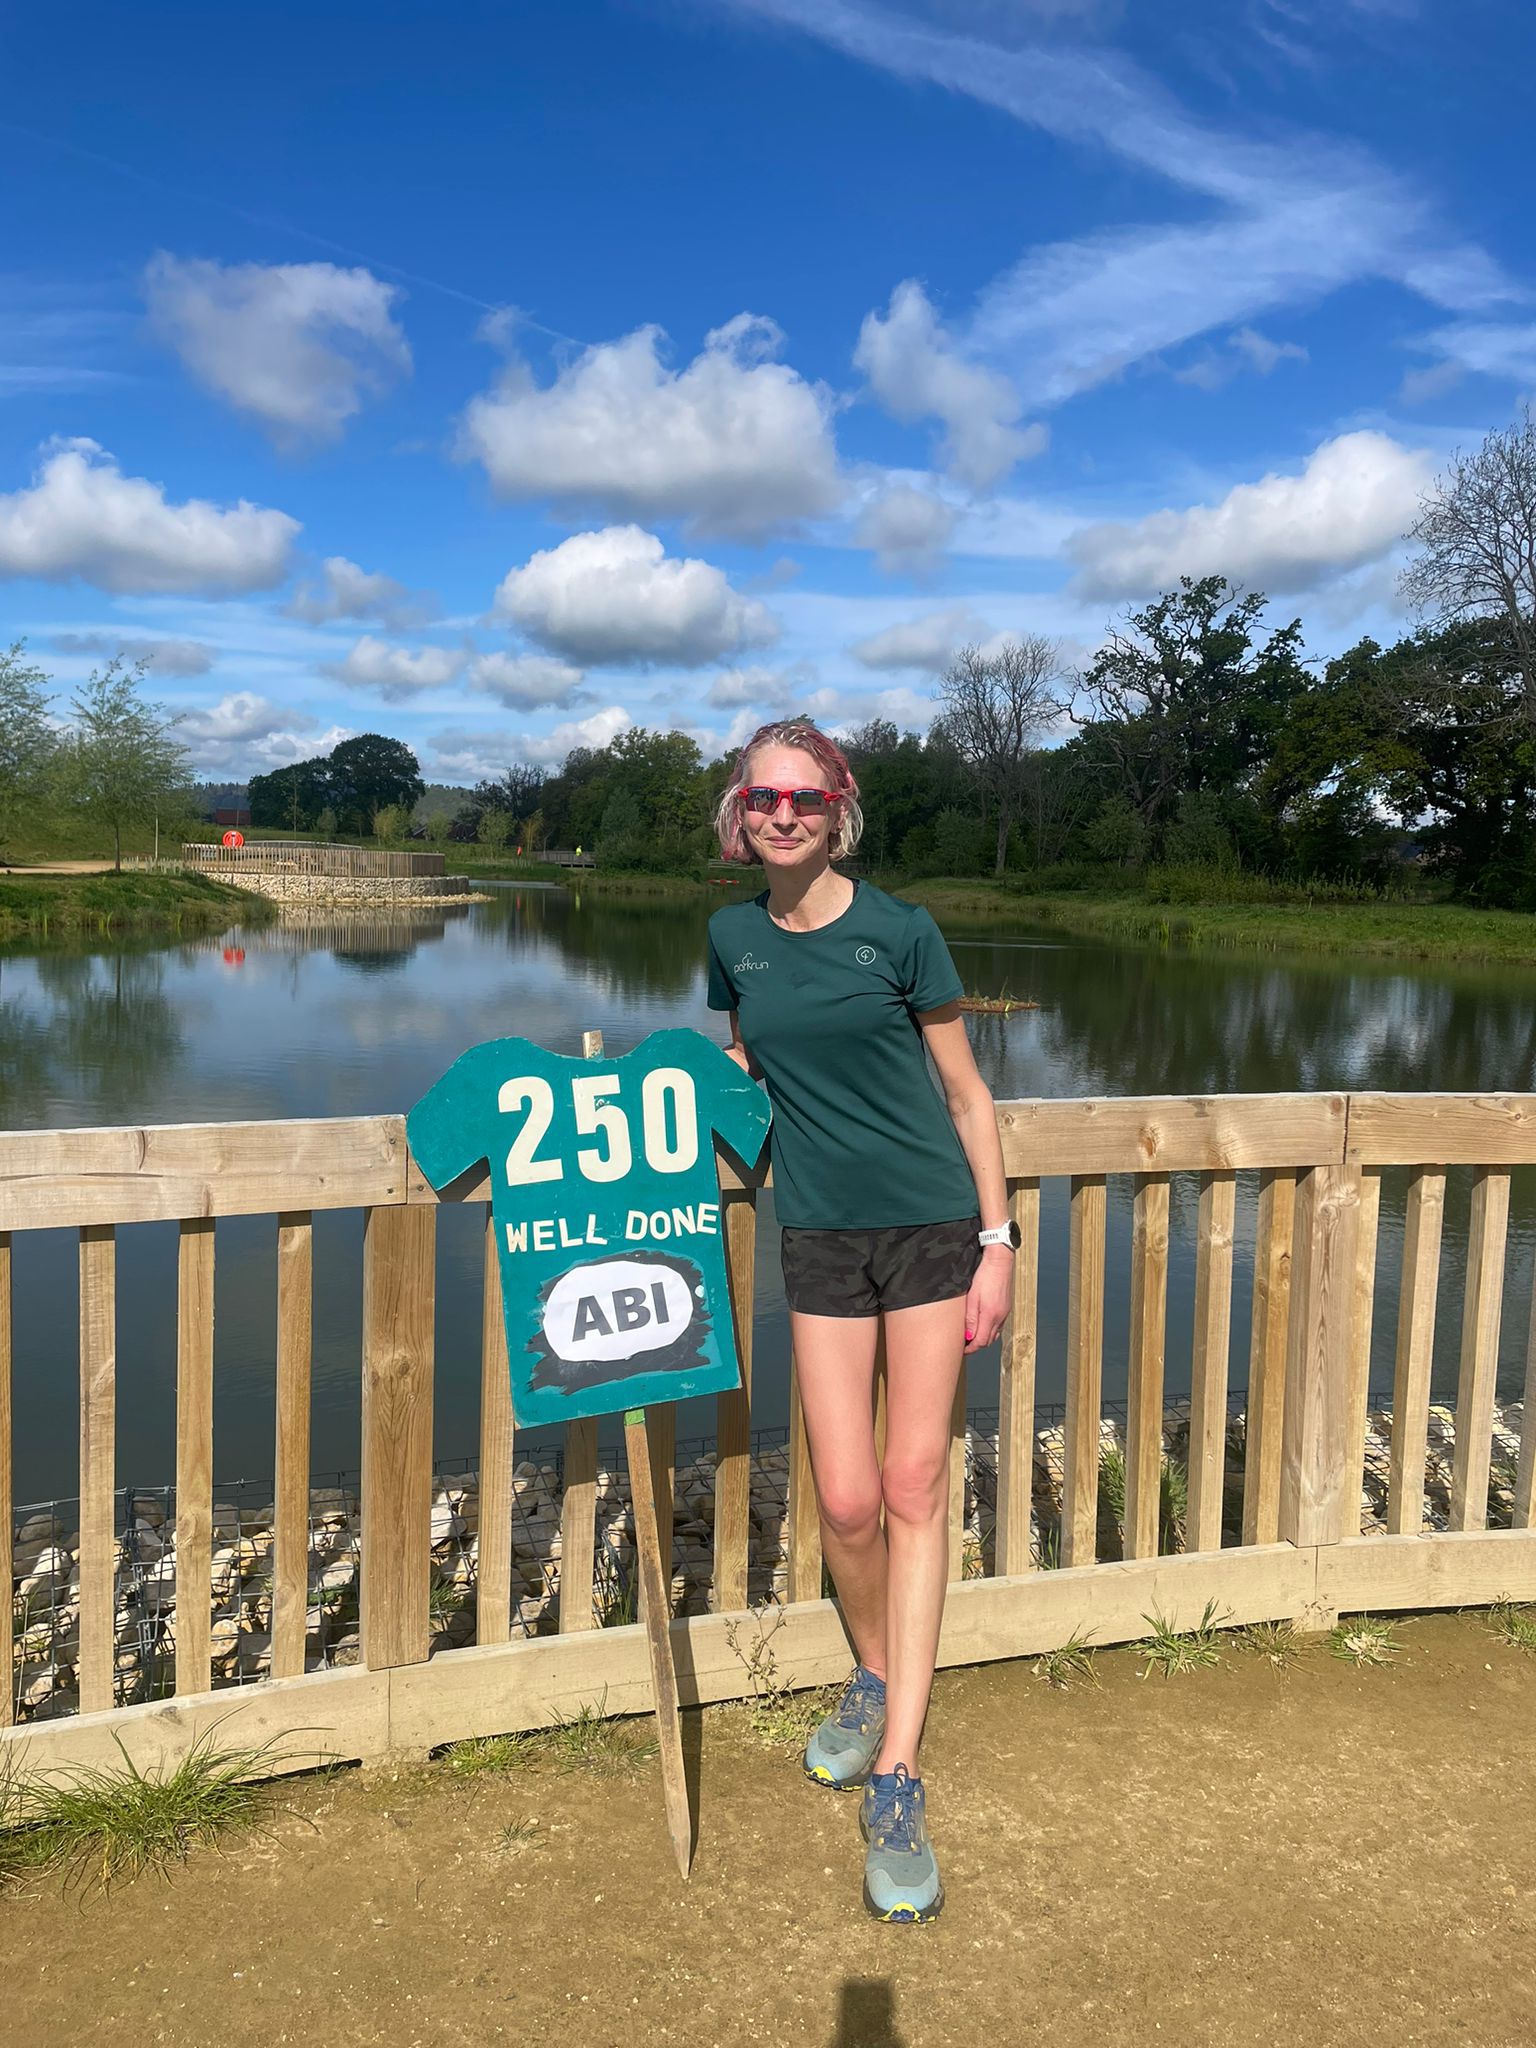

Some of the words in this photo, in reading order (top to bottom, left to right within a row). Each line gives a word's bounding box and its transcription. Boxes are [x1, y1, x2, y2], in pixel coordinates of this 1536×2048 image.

[733, 952, 769, 975] parkrun
[498, 1067, 699, 1186] 250
[506, 1214, 608, 1254] WELL
[626, 1203, 719, 1242] DONE
[572, 1282, 670, 1343] ABI
